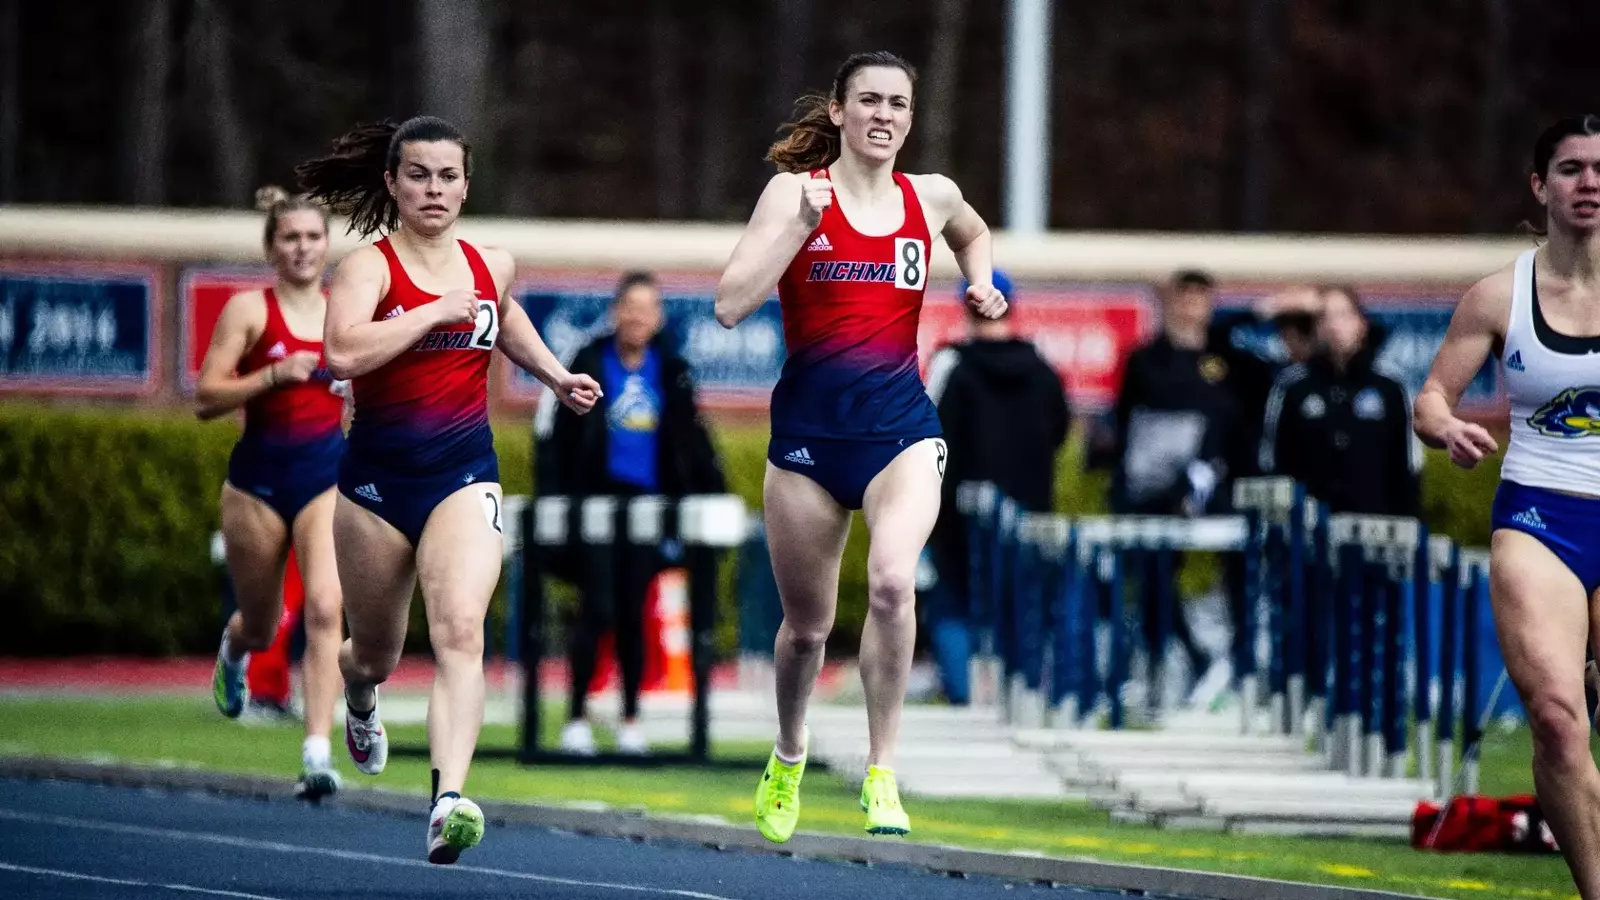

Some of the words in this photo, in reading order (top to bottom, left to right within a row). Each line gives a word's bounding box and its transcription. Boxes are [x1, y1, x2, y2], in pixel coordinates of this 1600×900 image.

[903, 241, 920, 286] 8
[476, 304, 493, 347] 2
[784, 455, 815, 466] adidas
[485, 492, 502, 534] 2
